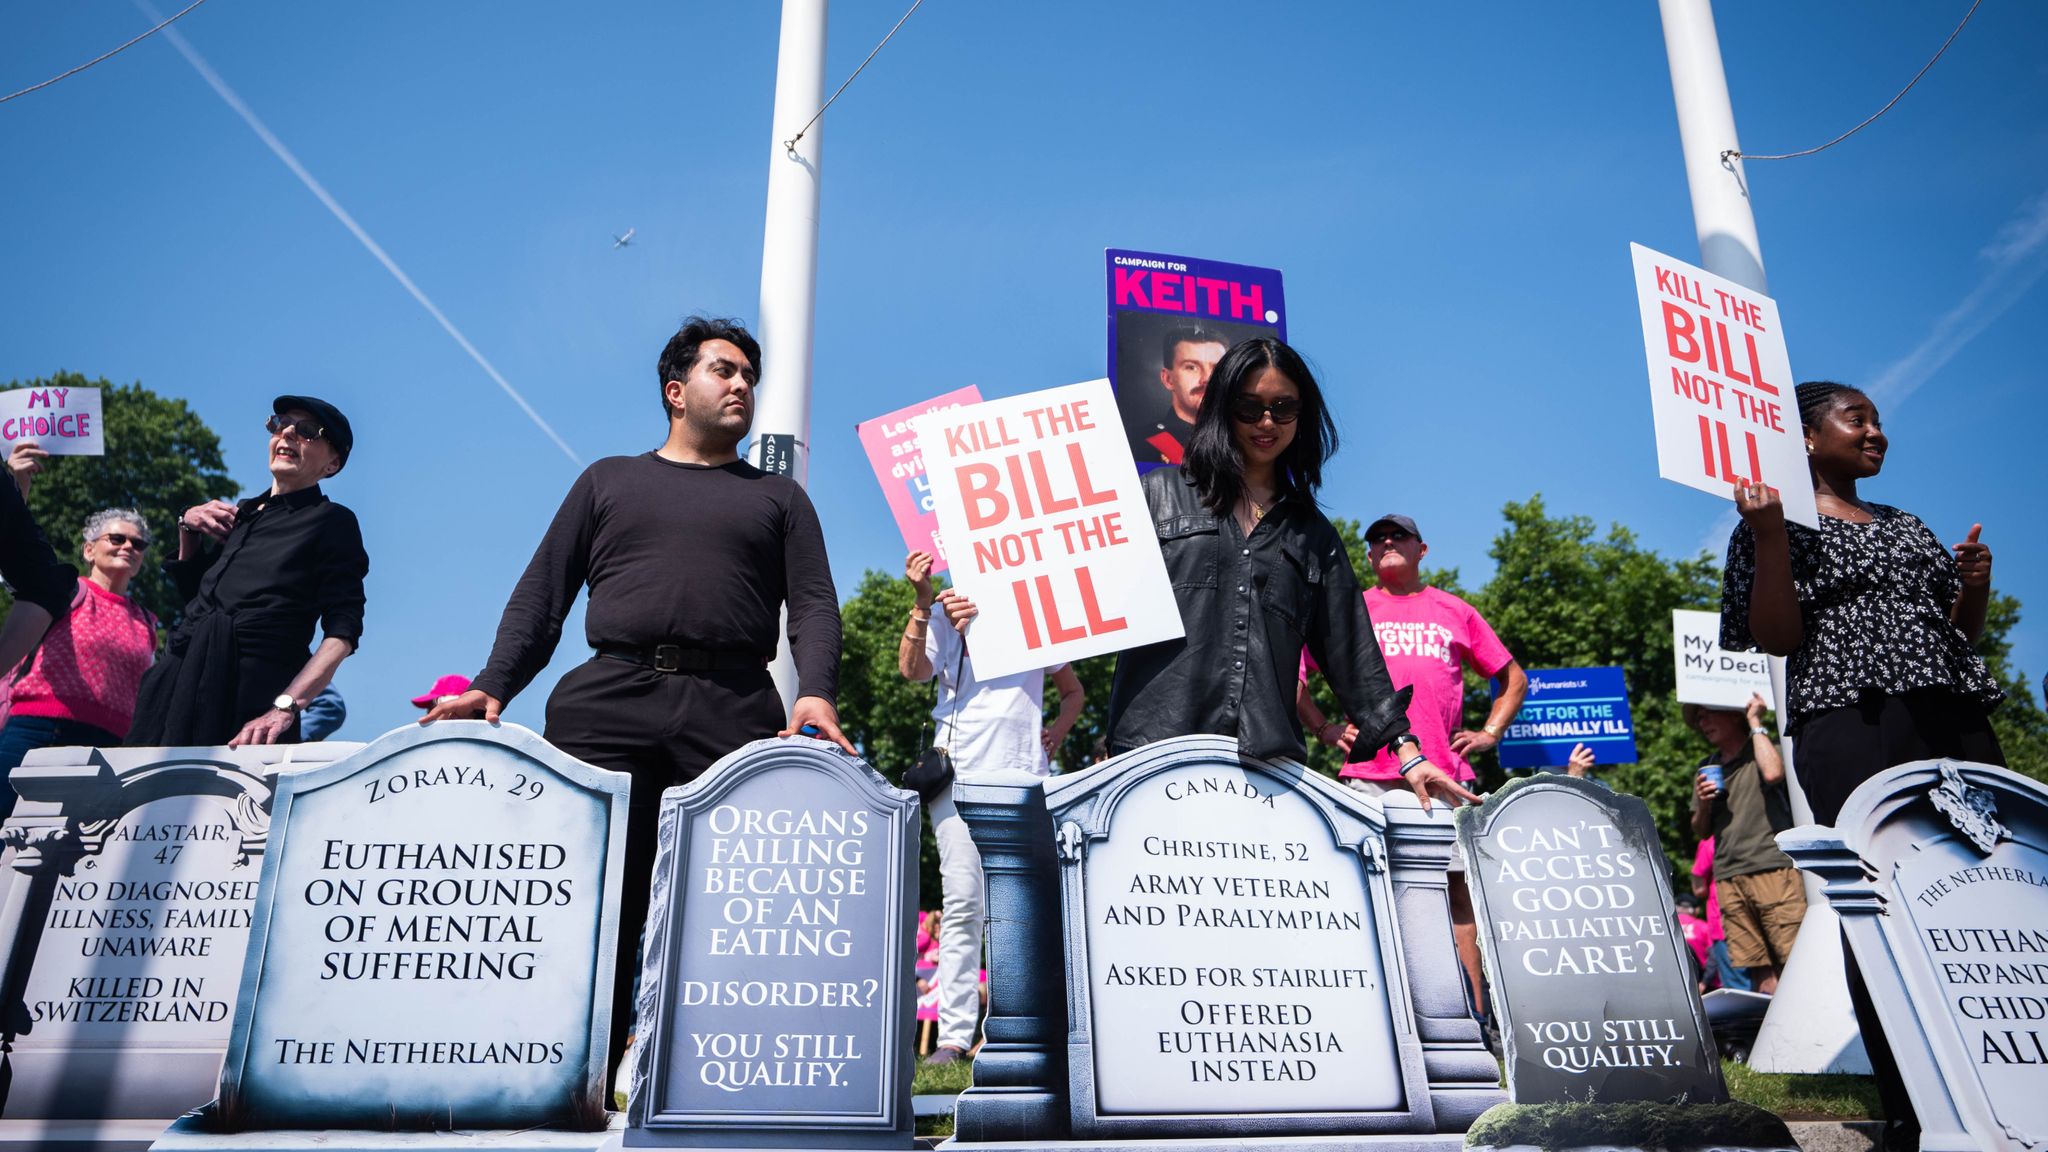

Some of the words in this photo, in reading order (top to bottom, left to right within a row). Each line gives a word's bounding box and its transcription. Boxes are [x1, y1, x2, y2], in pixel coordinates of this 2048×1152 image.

[1114, 256, 1165, 270] CAMPAIGN
[1168, 263, 1187, 272] FOR
[1115, 268, 1278, 324] KEITH.
[1655, 265, 1710, 310] KILL
[1713, 288, 1765, 332] THE
[1661, 300, 1779, 396] BILL
[28, 388, 69, 408] MY
[1671, 366, 1724, 410] NOT
[1732, 388, 1785, 434] THE
[944, 416, 1019, 457] KILL
[1024, 399, 1095, 439] THE
[779, 451, 787, 474] IS
[1698, 414, 1779, 498] ILL
[954, 442, 1118, 531] BILL
[973, 528, 1049, 574] NOT
[1054, 512, 1128, 554] THE
[1011, 566, 1128, 650] ILL
[1374, 622, 1425, 630] MPAIGN
[1374, 630, 1453, 647] IGNITY
[1684, 635, 1713, 653] My
[1685, 654, 1714, 673] My
[1720, 657, 1769, 674] Deci
[1539, 681, 1577, 689] Humanists
[1577, 680, 1587, 688] UK
[1516, 708, 1543, 720] ACT
[1546, 706, 1578, 719] FOR
[1580, 705, 1613, 718] THE
[1603, 720, 1629, 733] ILL
[364, 767, 494, 803] ZORAYA,
[508, 774, 545, 801] 29
[1165, 777, 1276, 809] CANADA
[709, 805, 868, 836] ORGANS
[114, 824, 230, 843] ALASTAIR,
[154, 846, 184, 864] 47
[322, 840, 566, 869] EUTHANISED
[711, 838, 864, 865] FAILING
[1144, 837, 1275, 861] CHRISTINE,
[1285, 843, 1308, 861] 52
[1496, 851, 1637, 882] ACCESS
[56, 882, 98, 901] NO
[107, 881, 259, 900] DIAGNOSED
[305, 880, 365, 906] ON
[378, 879, 572, 906] GROUNDS
[704, 868, 865, 895] BECAUSE
[1130, 874, 1203, 894] ARMY
[1213, 877, 1329, 898] VETERAN
[1917, 879, 1951, 907] THE
[1513, 884, 1635, 912] GOOD
[50, 909, 153, 929] ILLNESS,
[164, 909, 253, 928] FAMILY
[724, 898, 773, 924] OF
[783, 898, 841, 925] AN
[1105, 905, 1165, 925] AND
[1178, 904, 1360, 930] PARALYMPIAN
[325, 916, 376, 942] OF
[386, 916, 542, 942] MENTAL
[1497, 916, 1664, 940] PALLIATIVE
[82, 937, 212, 956] UNAWARE
[709, 928, 853, 956] EATING
[321, 952, 535, 980] SUFFERING
[1523, 940, 1654, 976] CARE?
[67, 978, 163, 998] KILLED
[172, 978, 204, 997] IN
[1106, 964, 1186, 986] ASKED
[1196, 968, 1246, 986] FOR
[1253, 968, 1374, 989] STAIRLIFT,
[682, 979, 878, 1007] DISORDER?
[32, 1001, 229, 1023] SWITZERLAND
[1181, 1000, 1311, 1025] OFFERED
[1958, 996, 2048, 1019] CHID
[1159, 1032, 1343, 1053] EUTHANASIA
[1525, 1021, 1591, 1043] YOU
[1603, 1020, 1684, 1041] STILL
[275, 1039, 334, 1063] THE
[344, 1039, 563, 1063] NETHERLANDS
[691, 1034, 762, 1058] YOU
[774, 1034, 861, 1059] STILL
[1543, 1045, 1680, 1073] QUALIFY.
[700, 1061, 848, 1091] QUALIFY.
[1192, 1060, 1316, 1081] INSTEAD
